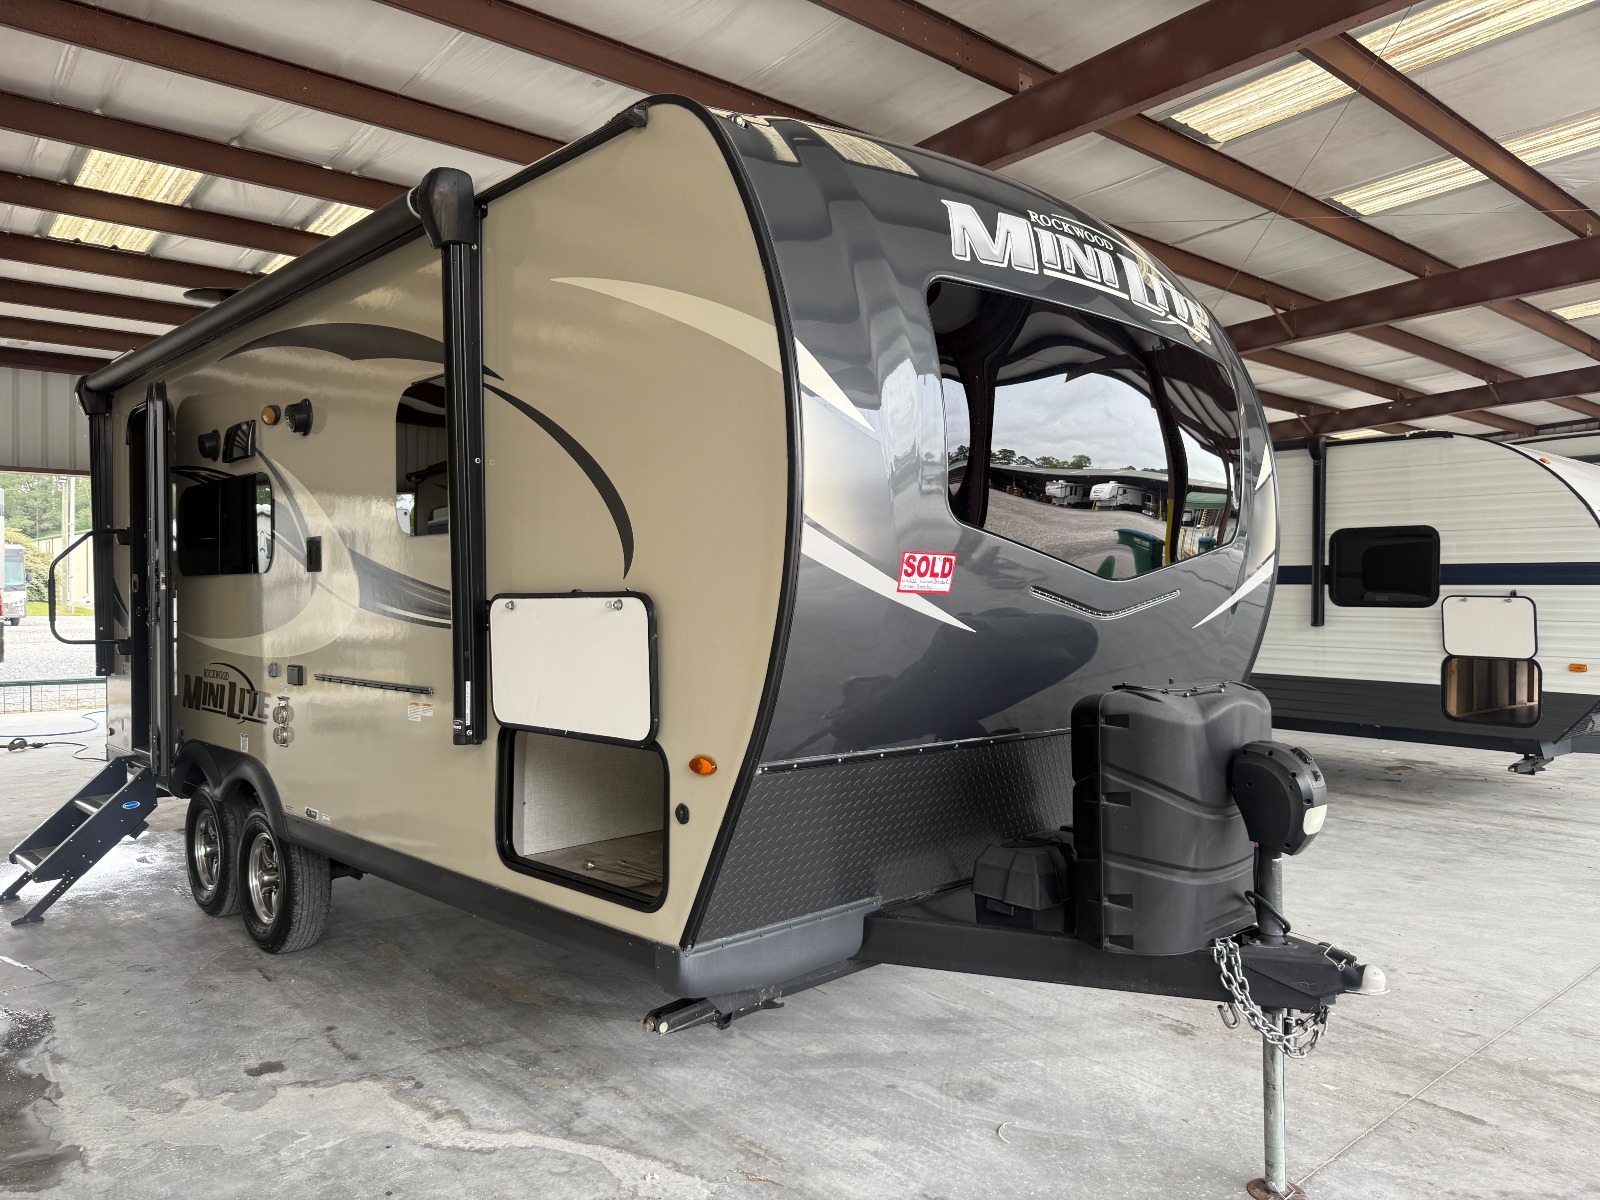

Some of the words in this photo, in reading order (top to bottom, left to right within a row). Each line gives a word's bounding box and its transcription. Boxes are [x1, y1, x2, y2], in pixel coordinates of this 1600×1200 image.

[1027, 209, 1114, 251] ROCKWOOD
[940, 198, 1120, 289] MINI
[1116, 252, 1211, 339] LITE
[903, 554, 954, 579] SOLD
[182, 673, 226, 711] MINI
[226, 681, 272, 719] LITE
